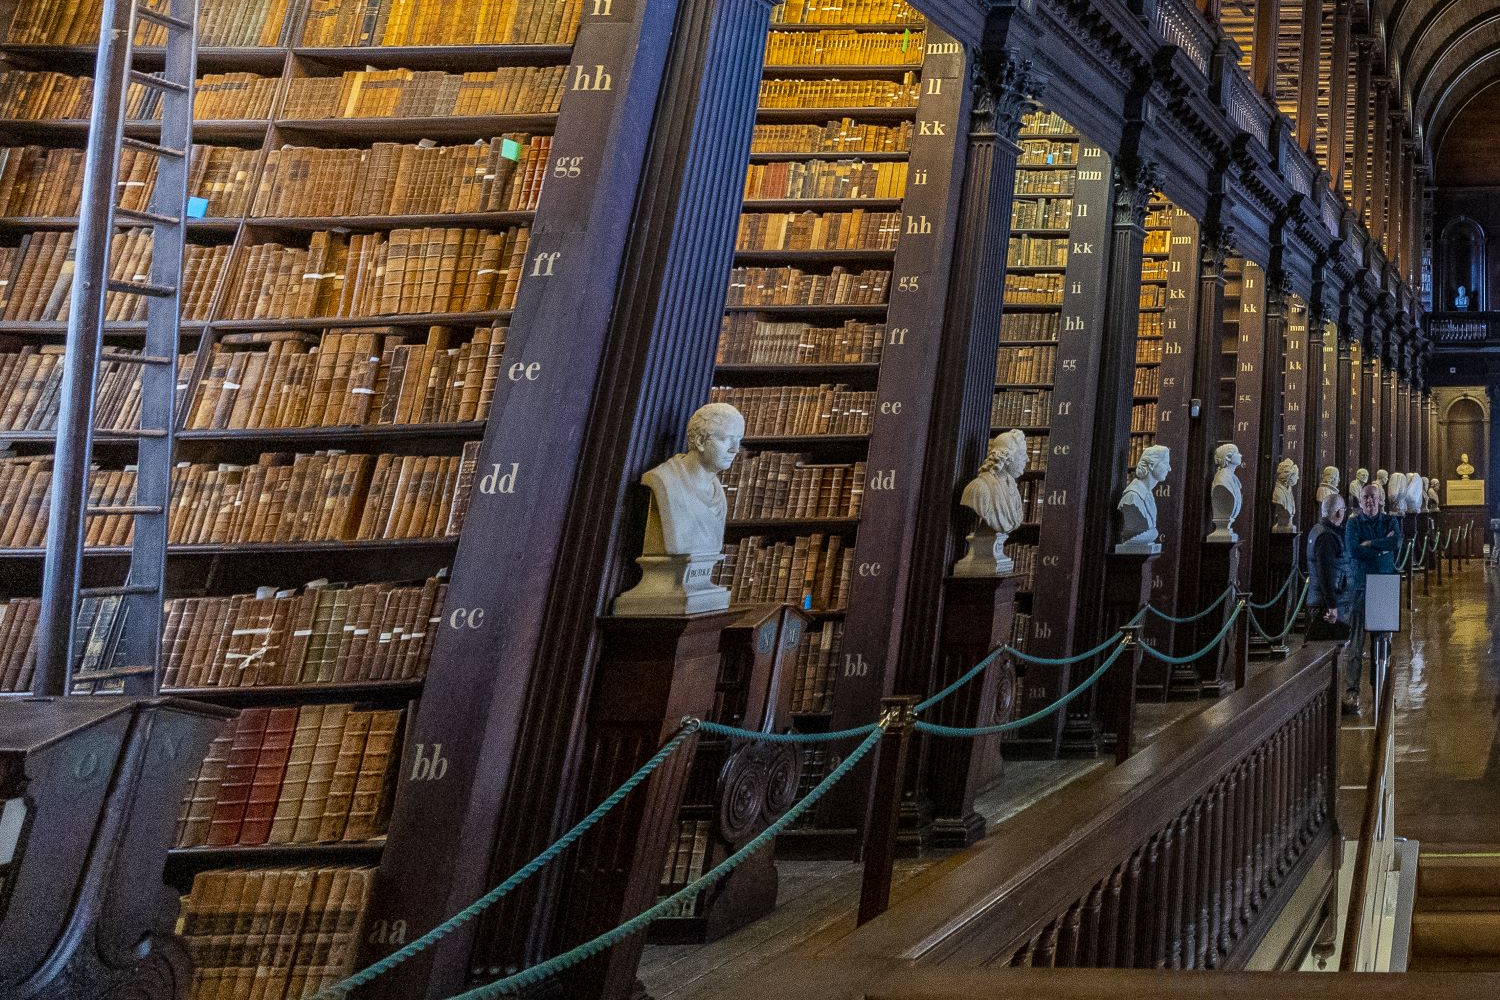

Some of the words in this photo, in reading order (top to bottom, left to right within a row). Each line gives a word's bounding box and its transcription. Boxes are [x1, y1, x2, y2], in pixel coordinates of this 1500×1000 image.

[927, 41, 959, 54] mm
[571, 65, 612, 91] hh
[926, 79, 942, 95] ll
[919, 121, 946, 136] kk
[1083, 147, 1101, 157] nn
[554, 155, 583, 178] gg
[914, 169, 928, 185] ii
[1078, 171, 1102, 180] mm
[1077, 204, 1088, 217] ll
[906, 217, 932, 235] hh
[1172, 235, 1192, 245] mm
[1073, 242, 1093, 254] kk
[530, 252, 561, 277] ff
[1171, 261, 1182, 273] ll
[898, 275, 919, 292] gg
[1071, 281, 1082, 293] ii
[1169, 288, 1186, 299] kk
[1065, 316, 1085, 330] hh
[1168, 319, 1177, 329] ii
[889, 328, 909, 346] ff
[1165, 342, 1182, 354] hh
[508, 360, 542, 382] ee
[1062, 358, 1077, 373] gg
[1163, 375, 1175, 387] gg
[880, 401, 902, 415] ee
[1058, 401, 1072, 415] ff
[1160, 410, 1172, 422] ff
[1053, 444, 1070, 455] ee
[479, 462, 519, 495] dd
[870, 470, 896, 490] dd
[1155, 484, 1171, 497] dd
[1048, 491, 1067, 505] dd
[1043, 556, 1060, 567] cc
[858, 561, 881, 577] cc
[449, 606, 485, 630] cc
[844, 654, 868, 677] bb
[410, 743, 448, 782] bb
